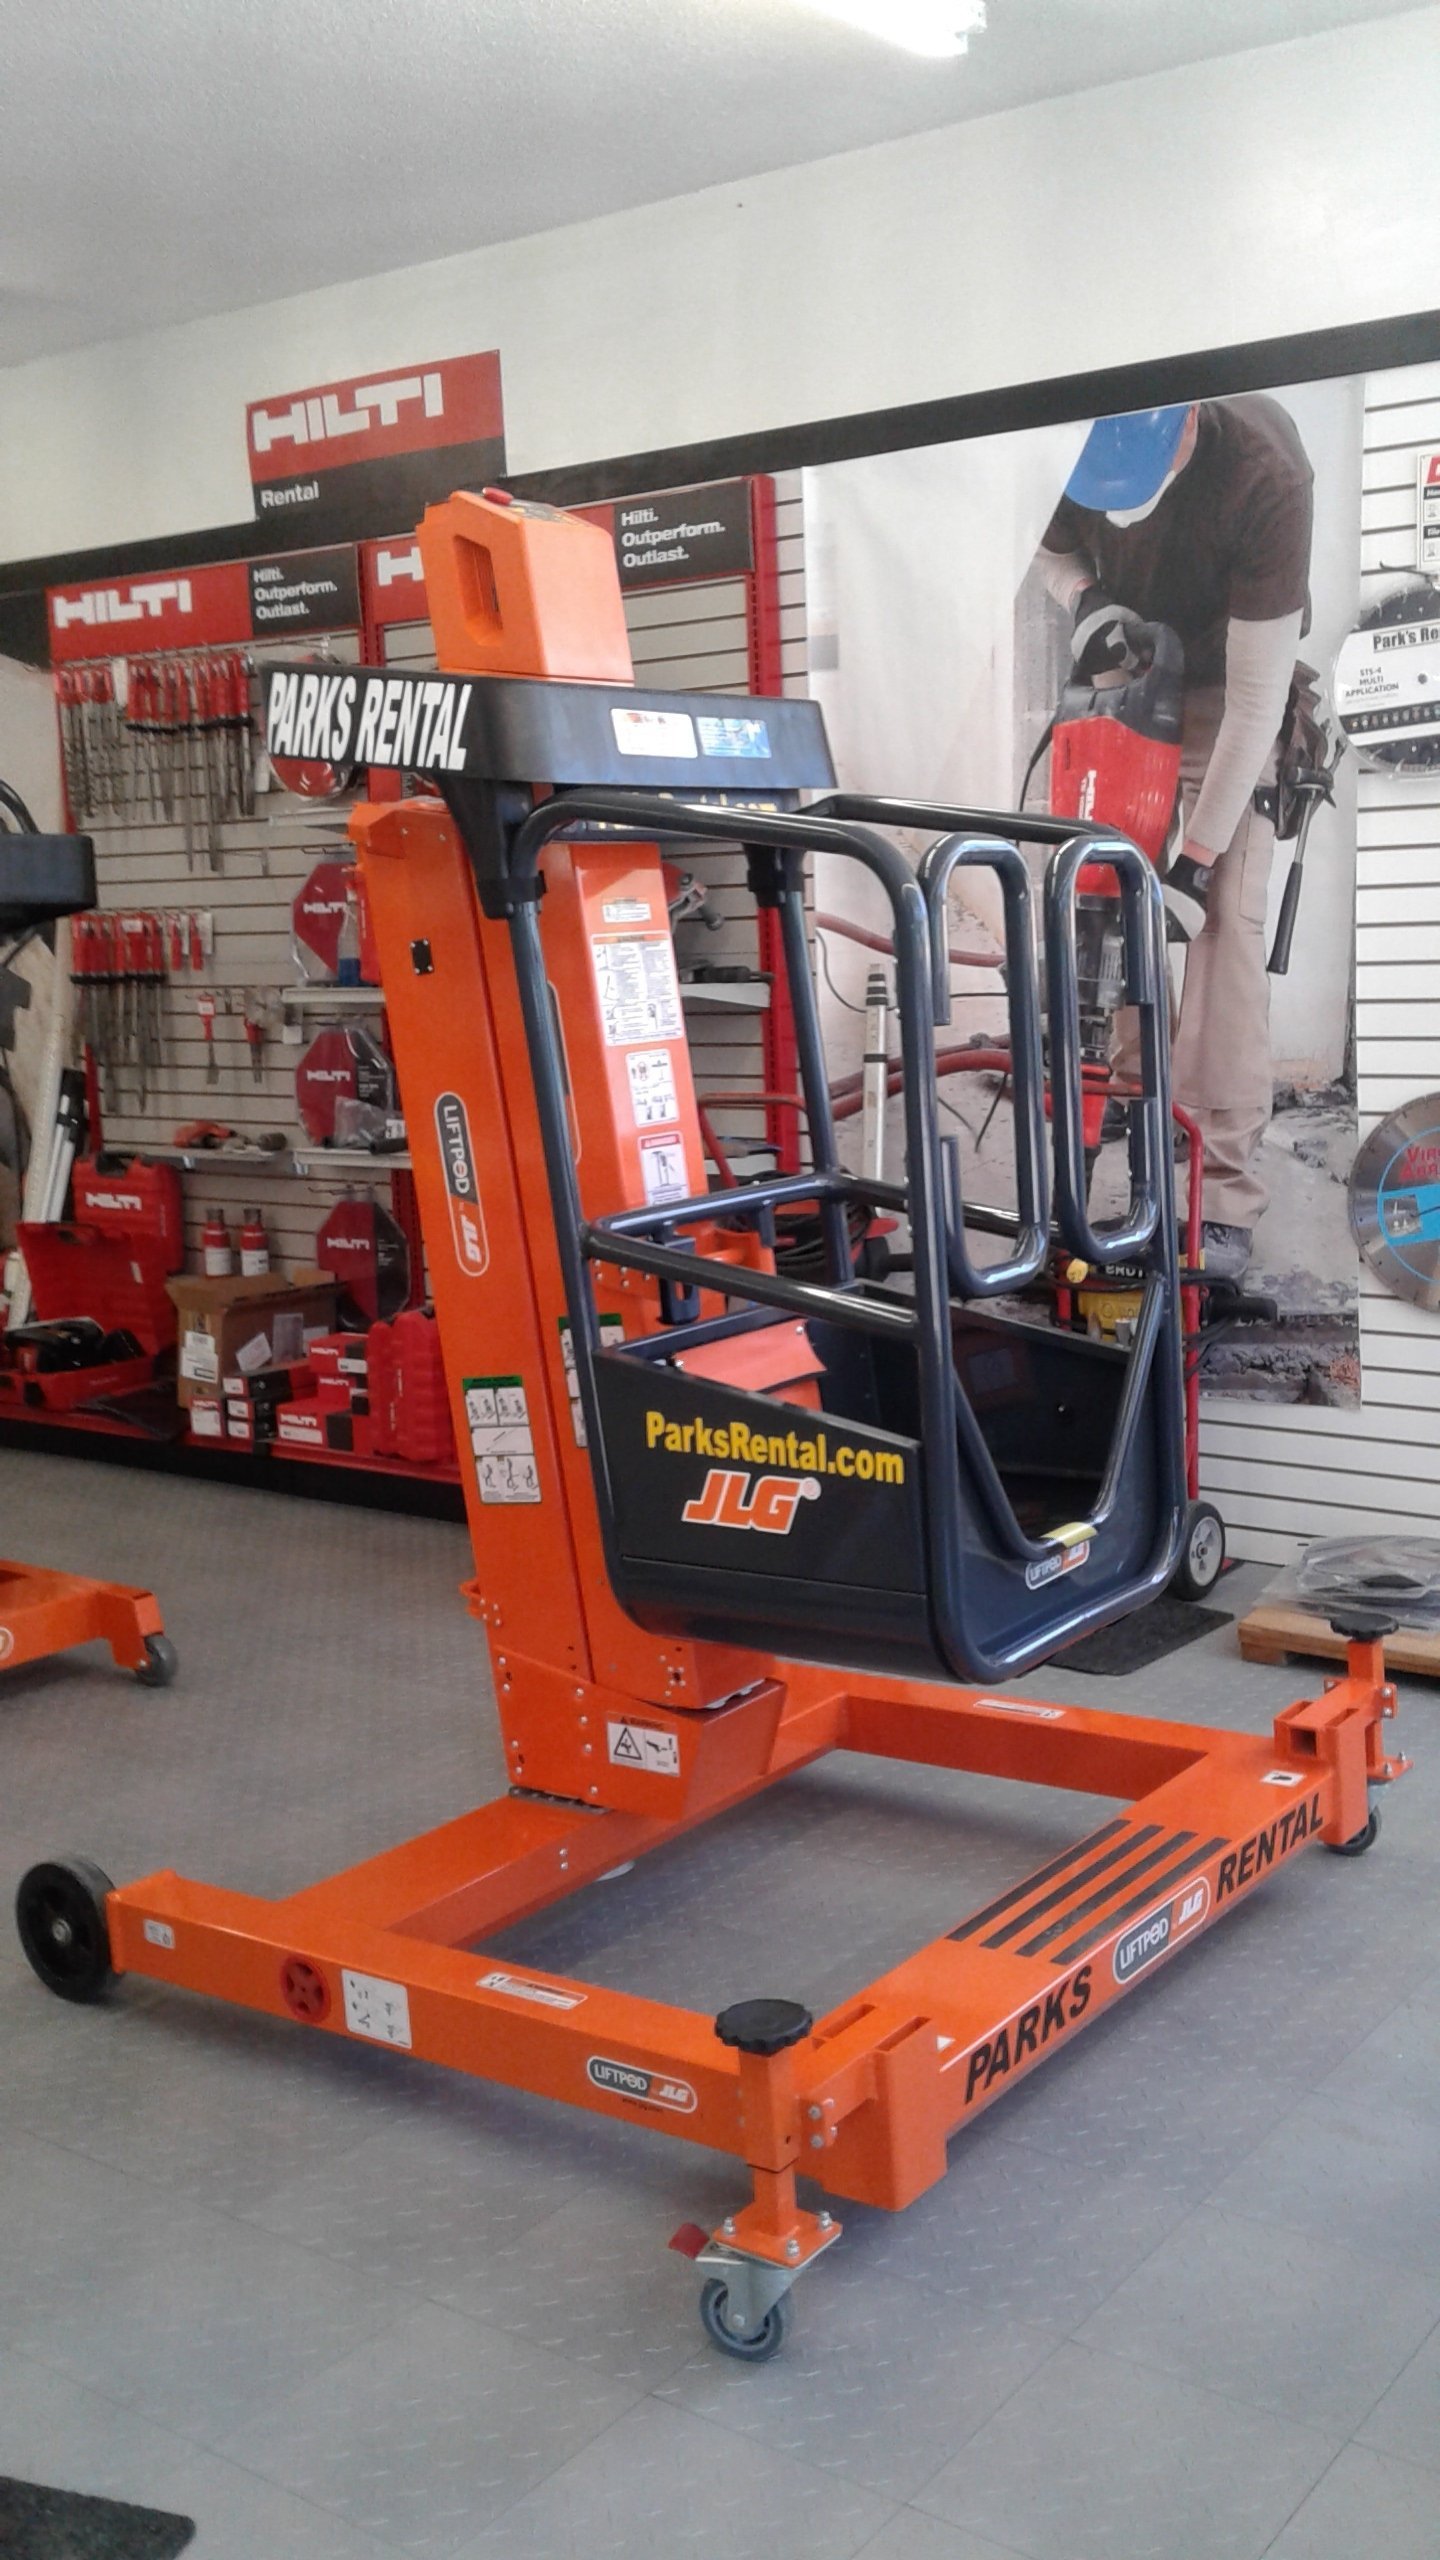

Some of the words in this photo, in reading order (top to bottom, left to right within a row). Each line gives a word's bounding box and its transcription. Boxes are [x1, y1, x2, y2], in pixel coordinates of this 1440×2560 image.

[253, 372, 444, 453] HILTI
[260, 481, 320, 509] Rental
[621, 508, 659, 526] Hilti.
[621, 521, 726, 547] Outperform.
[623, 546, 689, 568] Outlast.
[253, 567, 284, 583] Hilti.
[54, 579, 193, 629] HILTI
[254, 579, 338, 602] Outperform.
[256, 601, 310, 620] Outlast.
[1373, 630, 1417, 650] Park's
[267, 672, 357, 761] PARKS
[354, 678, 473, 770] RENTAL
[443, 1104, 470, 1194] LIFTPOD
[646, 1411, 904, 1484] ParksRental.com
[1217, 1793, 1323, 1903] RENTAL
[1119, 1917, 1169, 1971] LIFTPOD
[965, 1966, 1093, 2104] PARKS
[594, 2064, 648, 2091] LIFTPOD
